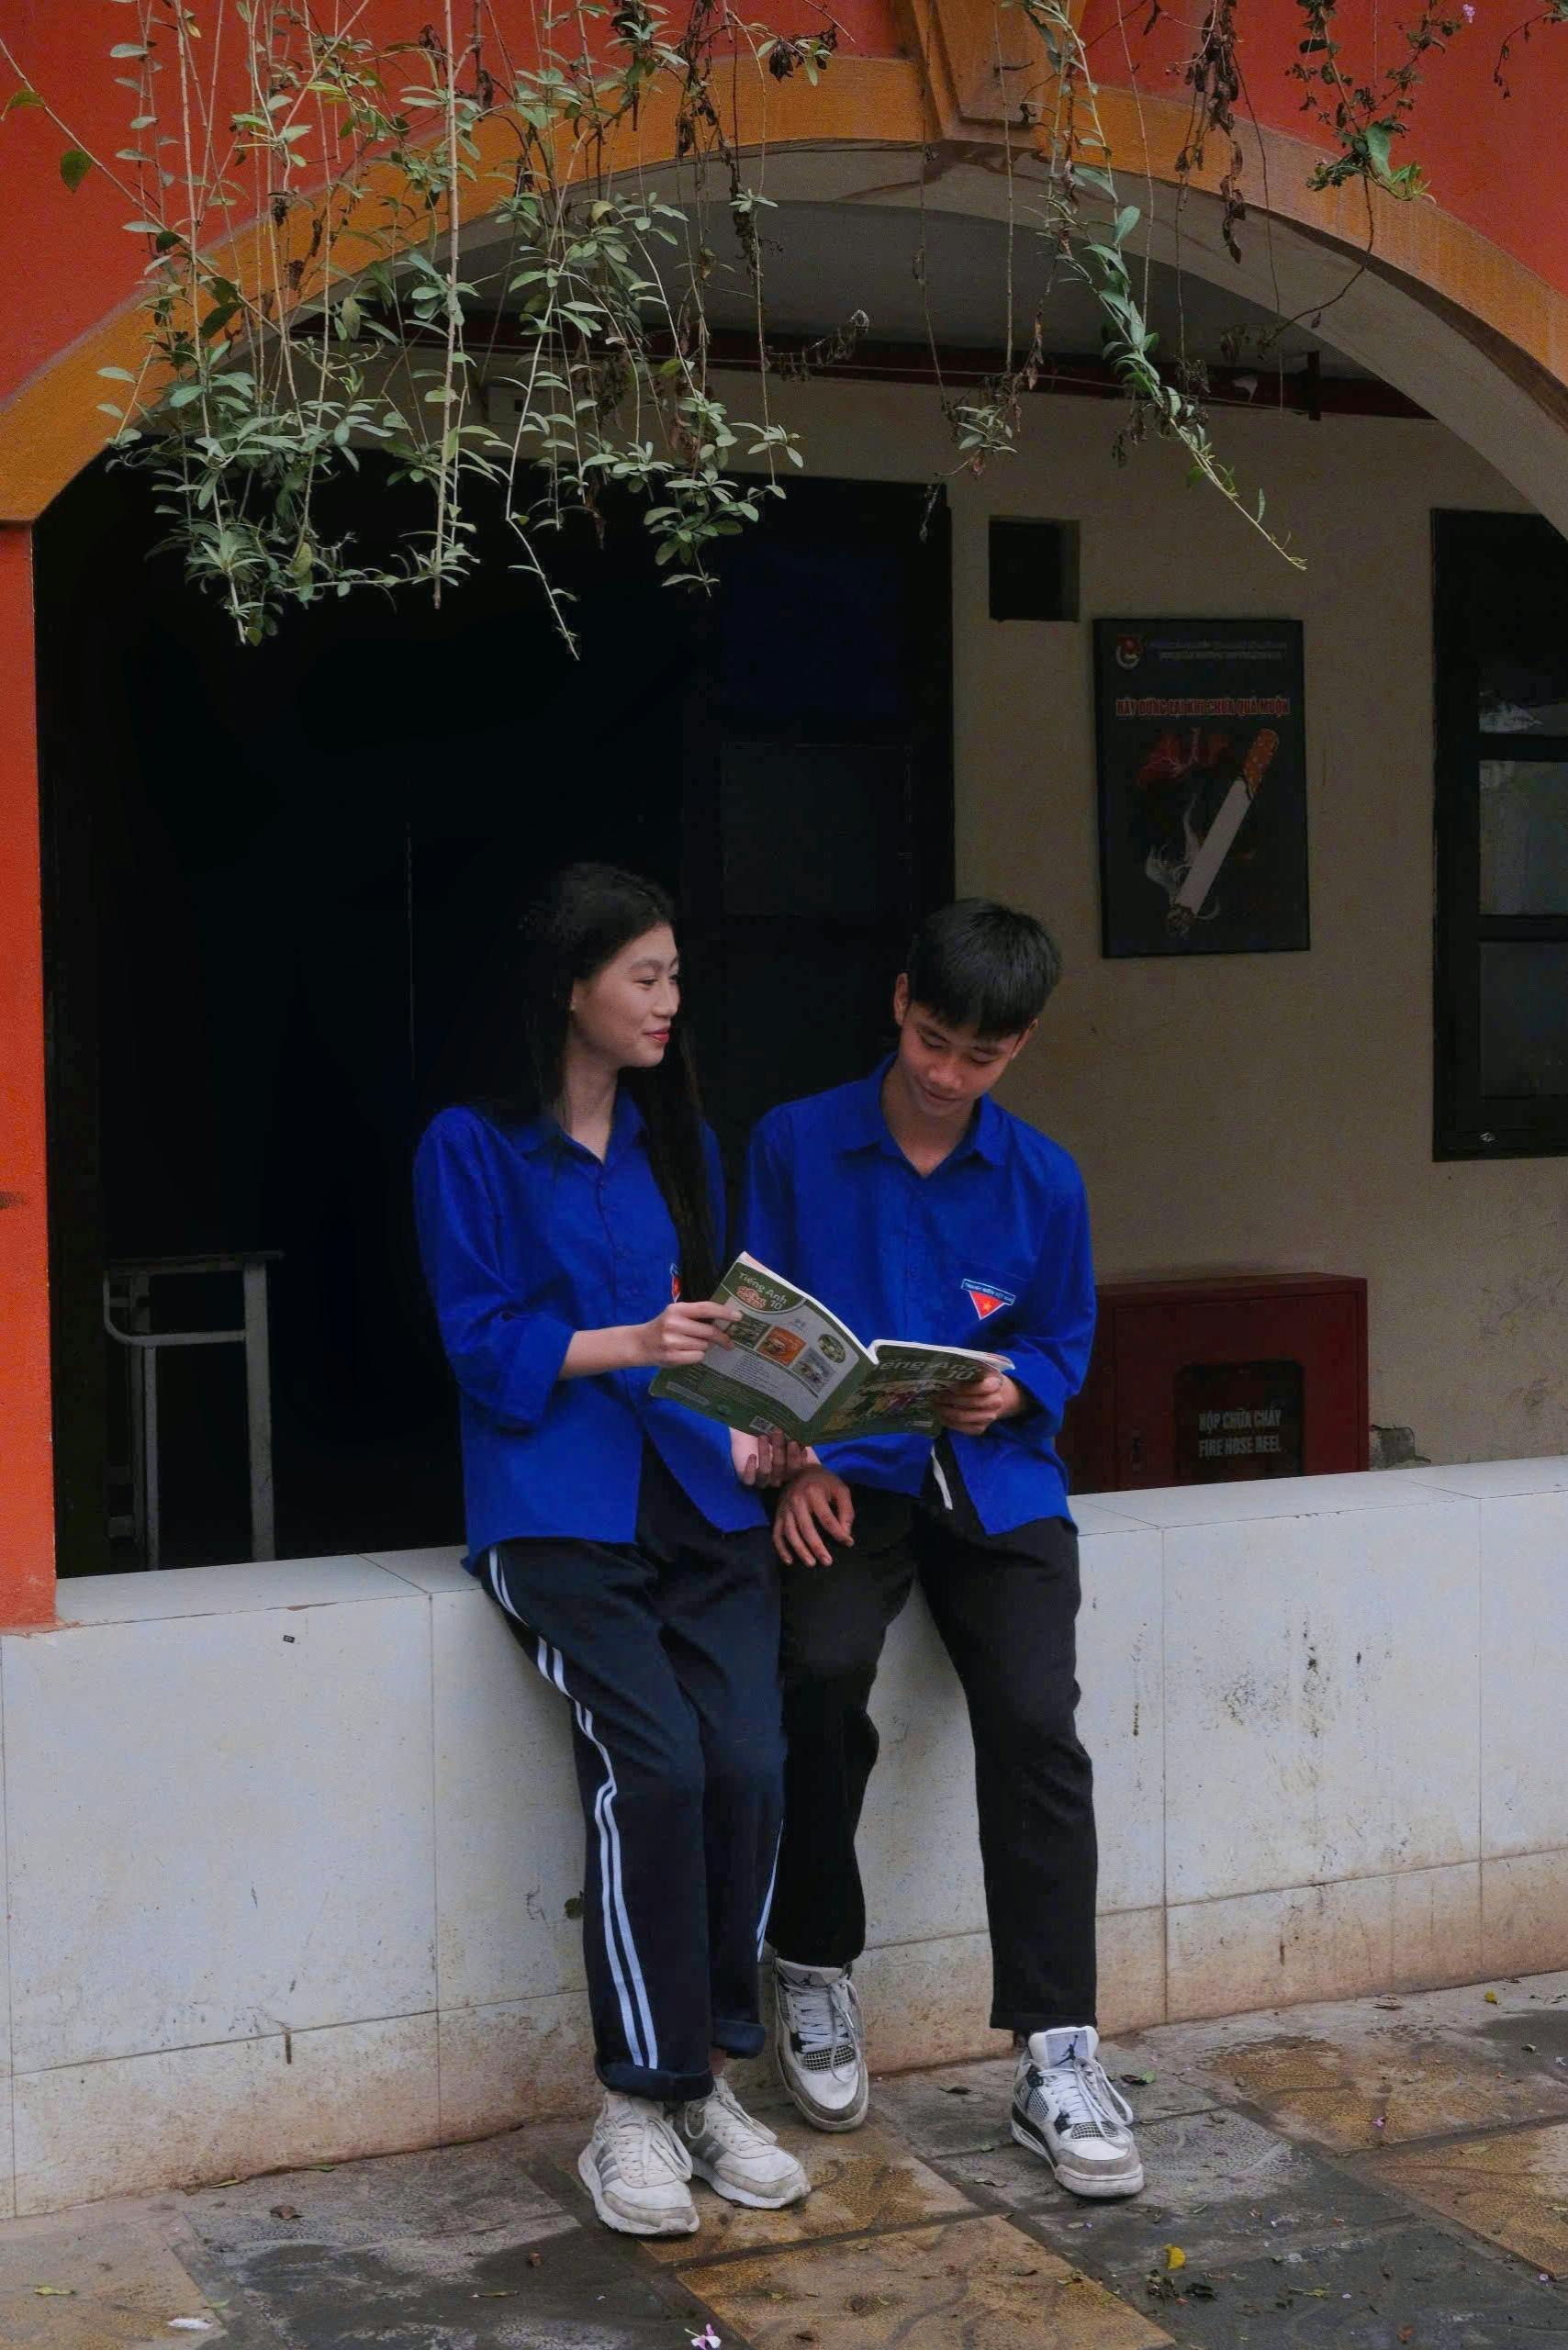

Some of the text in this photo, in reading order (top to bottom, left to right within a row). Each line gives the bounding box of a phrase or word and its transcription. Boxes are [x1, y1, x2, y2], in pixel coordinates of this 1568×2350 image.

[739, 1271, 765, 1293] Tiếng
[765, 1289, 788, 1305] Anh
[771, 1300, 782, 1311] 10
[1198, 1438, 1222, 1459] FIRE
[1224, 1437, 1253, 1455] HOSE
